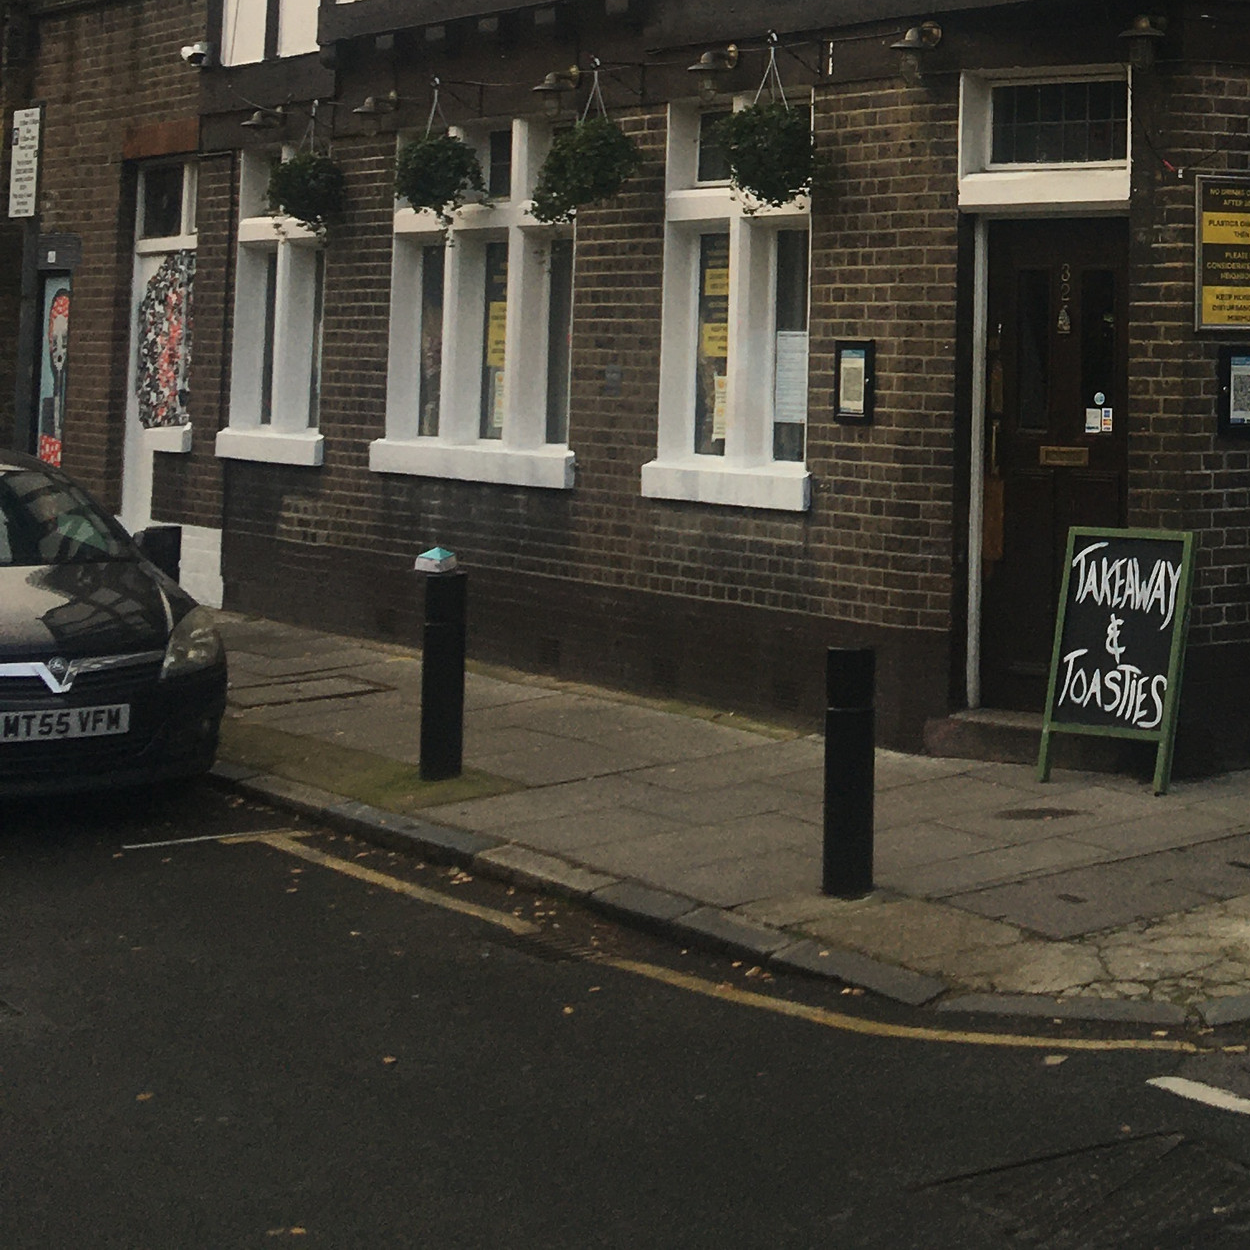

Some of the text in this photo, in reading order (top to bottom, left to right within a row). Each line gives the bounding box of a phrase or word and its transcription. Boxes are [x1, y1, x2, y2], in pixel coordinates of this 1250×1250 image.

[1072, 542, 1182, 630] TAKEAWAY
[1105, 613, 1126, 664] &
[3, 707, 121, 738] MT55 VFM
